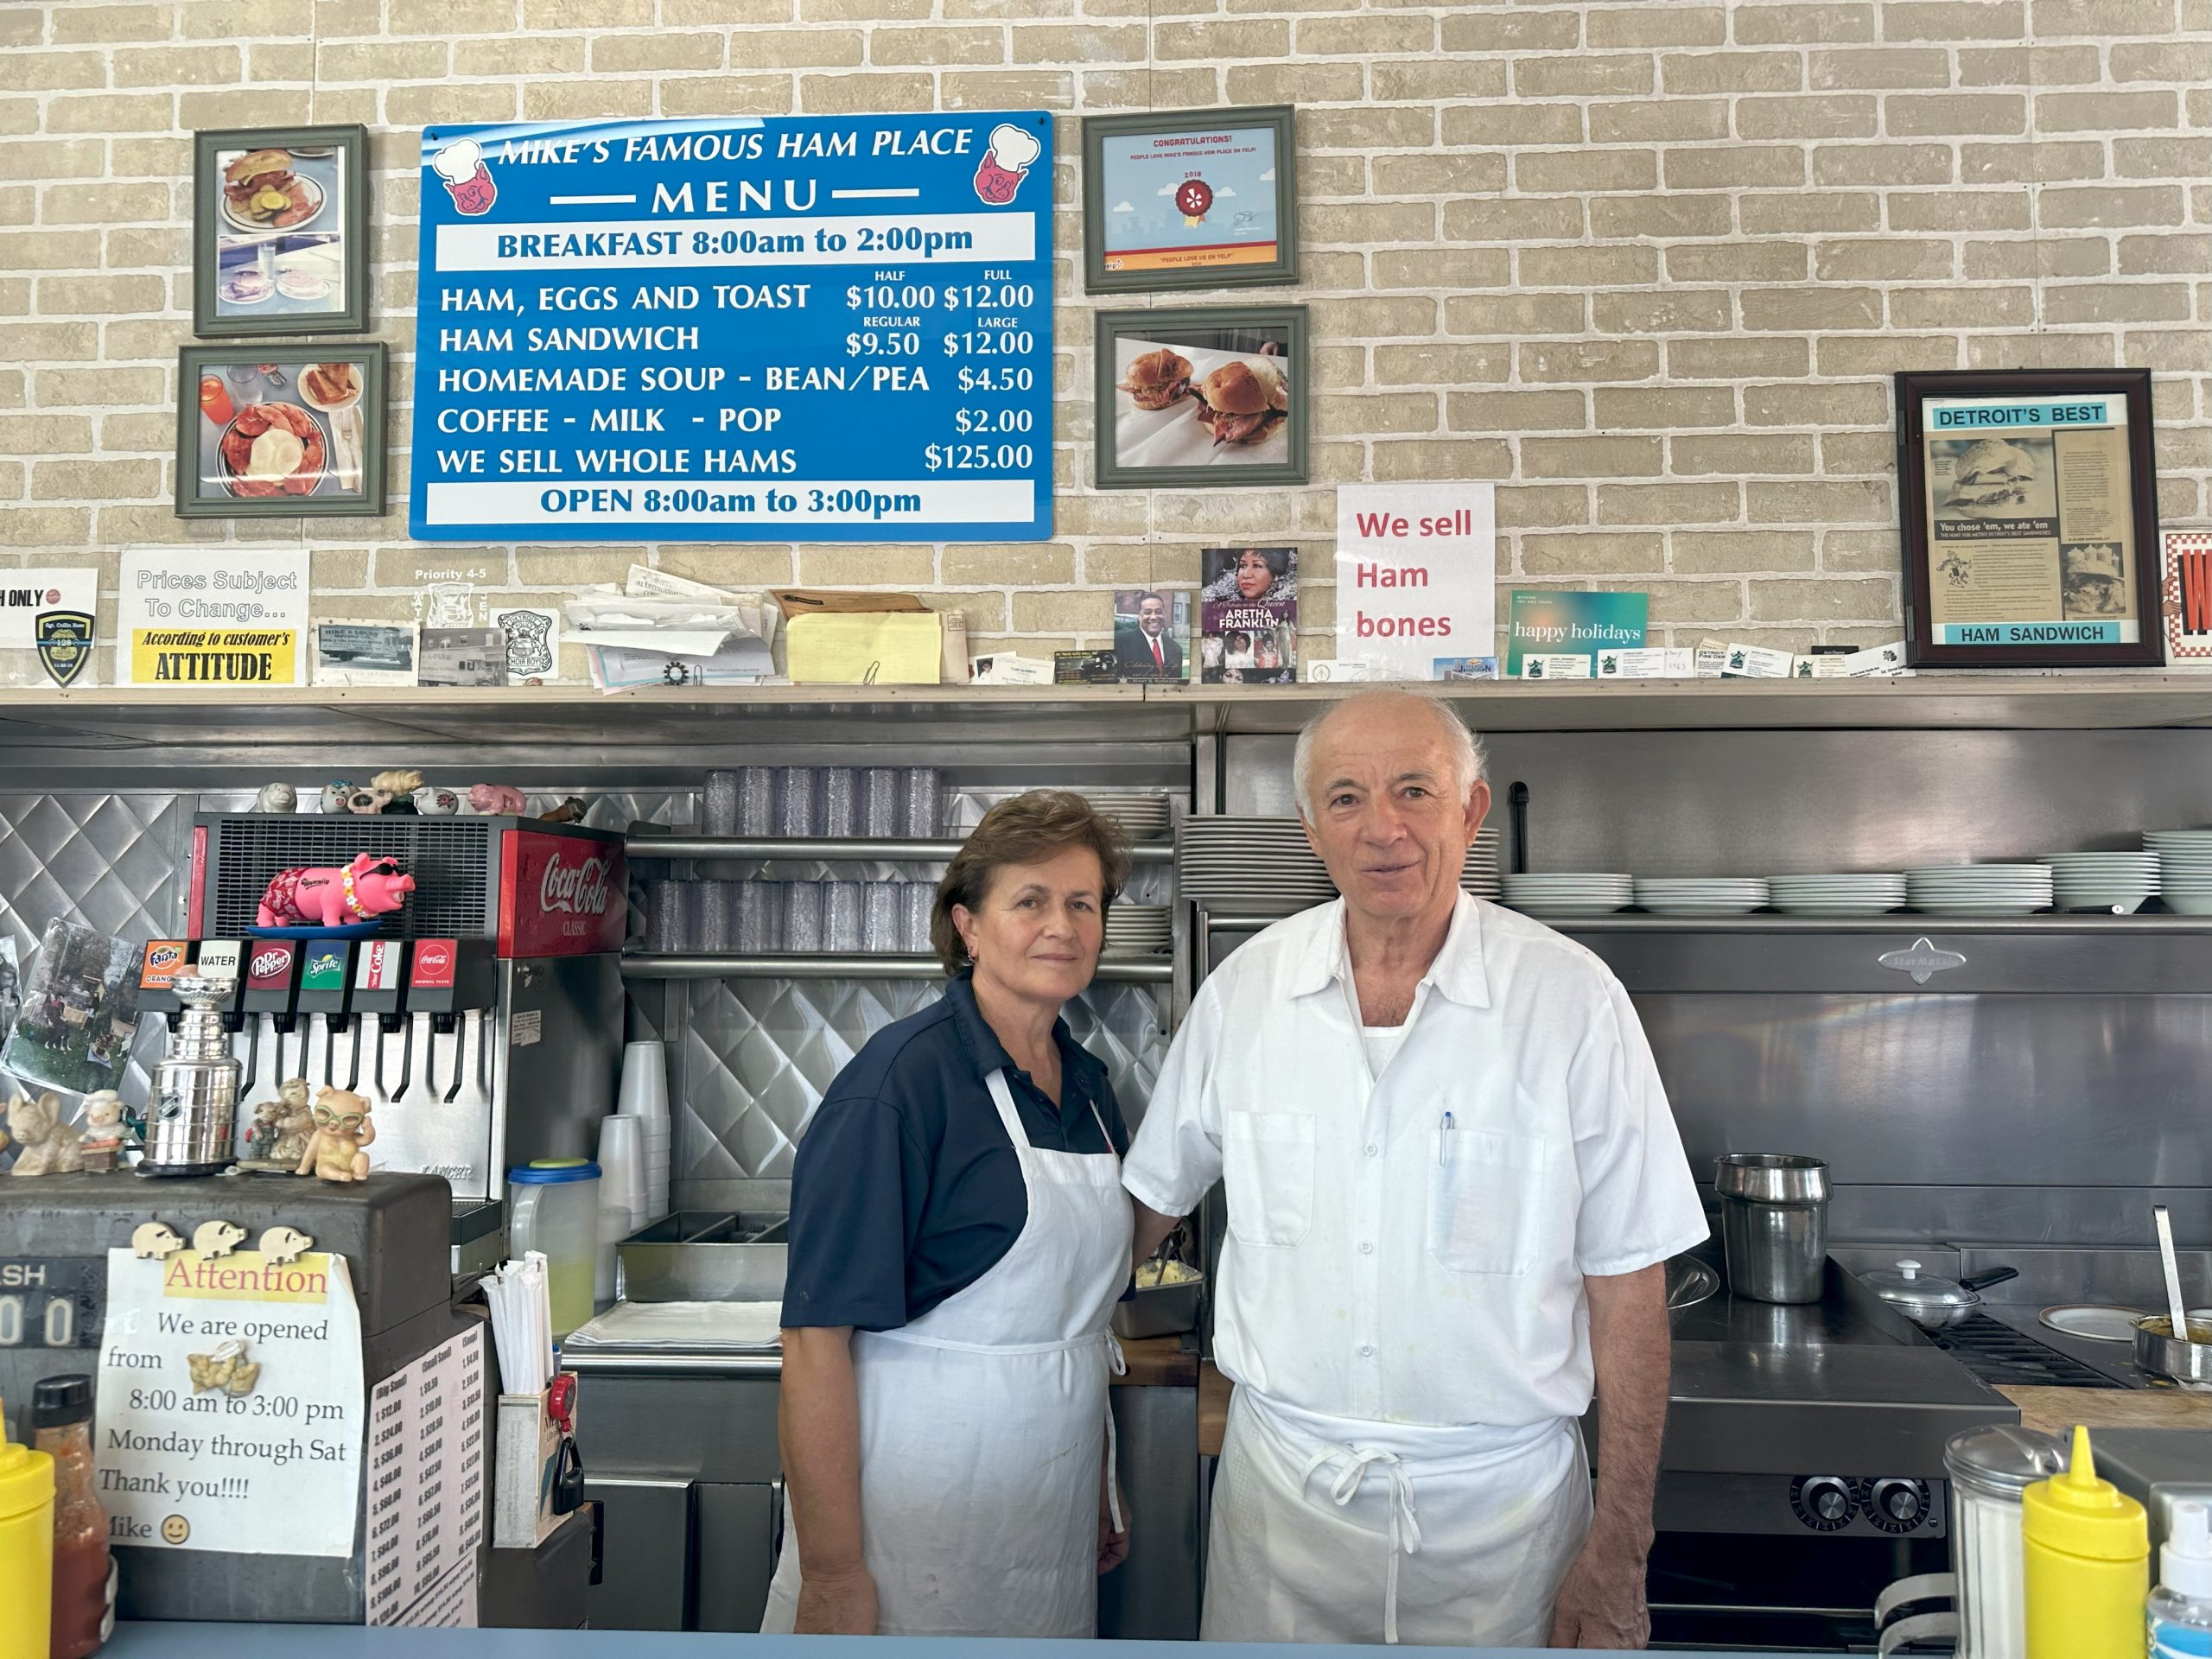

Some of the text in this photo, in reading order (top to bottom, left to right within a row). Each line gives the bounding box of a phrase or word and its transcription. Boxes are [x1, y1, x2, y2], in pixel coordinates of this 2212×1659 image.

[499, 128, 973, 165] MIKE'S FAMOUS HAM PLACE
[1154, 135, 1232, 147] CONGRATULATIONS!
[652, 179, 817, 213] MENU
[499, 227, 972, 257] BREAKFAST 8:00am to 2:00pm
[875, 270, 1012, 281] HALF FULL
[442, 284, 1033, 316] HAM, EGGS AND TOAST $10.00 $12.00
[864, 316, 1017, 327] REGULAR LARGE
[441, 327, 1033, 357] HAM SANDWICH $9.50 $12.00
[439, 368, 626, 391] HOMEMADE
[641, 367, 725, 391] SOUP
[766, 366, 929, 391] BEAN/PEA
[958, 366, 1033, 393] $4.50
[438, 409, 548, 433] COFFEE
[591, 409, 664, 431] MILK
[720, 408, 780, 431] POP
[957, 408, 1032, 435] $2.00
[1939, 405, 2103, 425] DETROIT'S BEST
[437, 443, 1033, 473] WE SELL WHOLE HAMS $125.00
[541, 489, 920, 519] OPEN 8:00am to 3:00pm
[1357, 509, 1472, 537] We sell
[1940, 523, 1955, 531] You
[1957, 522, 1980, 531] chose
[137, 570, 296, 594] Prices Subject
[415, 569, 486, 580] Priority 4-5
[1357, 563, 1428, 588] Ham
[9, 589, 44, 607] ONLY
[1257, 600, 1287, 610] Queen
[145, 598, 285, 621] To Change...
[511, 614, 537, 623] DETROIT
[1225, 609, 1273, 619] ARETHA
[1219, 618, 1280, 628] FRANKLIN
[1357, 610, 1452, 637] bones
[1515, 622, 1640, 644] happy holidays
[1961, 626, 2104, 641] HAM SANDWICH
[143, 632, 289, 646] According to customer's
[156, 652, 272, 680] ATTITUDE
[541, 852, 613, 913] Coca-Cola
[563, 920, 587, 936] CLASSIC
[149, 950, 178, 966] Fanta
[200, 956, 236, 966] WATER
[255, 956, 288, 976] Pepper
[264, 951, 278, 963] Dr
[310, 958, 339, 974] Sprite
[371, 944, 385, 973] Coke
[421, 954, 447, 963] Coca-Cola
[0, 1264, 46, 1286] SH
[165, 1258, 328, 1294] Attention
[158, 1313, 327, 1344] We are opened
[108, 1347, 162, 1370] from
[130, 1389, 344, 1425] 8:00 am to 3:00 pm
[382, 1399, 401, 1421] $12.00
[381, 1421, 403, 1443] $24.00
[108, 1429, 346, 1465] Monday through Sat
[381, 1443, 403, 1465] $36.00
[99, 1469, 249, 1502] Thank you!!!!
[380, 1465, 401, 1488] $48.00
[379, 1511, 399, 1535] $72.00
